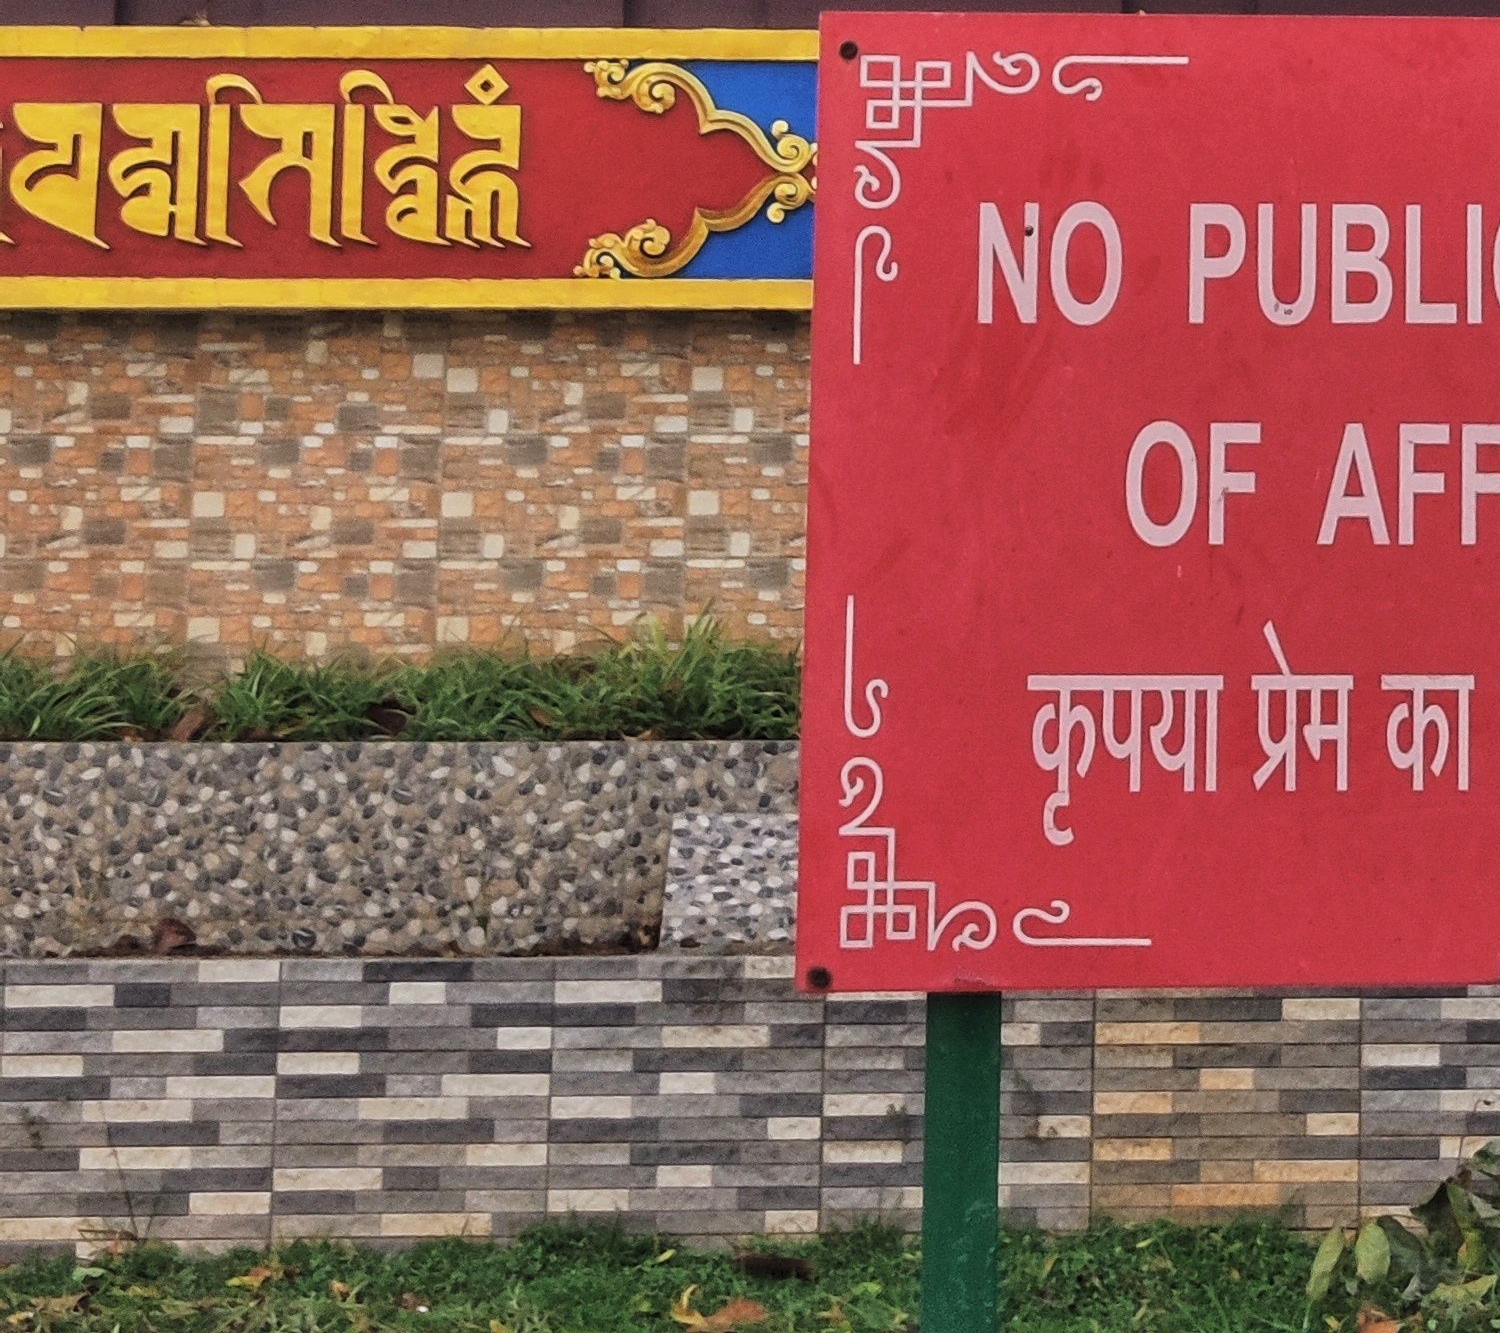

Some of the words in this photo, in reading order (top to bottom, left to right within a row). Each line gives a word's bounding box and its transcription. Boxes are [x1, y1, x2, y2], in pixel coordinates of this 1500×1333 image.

[977, 201, 1123, 326] NO
[1124, 420, 1262, 547] OF
[1027, 674, 1225, 846] कृपया
[1250, 620, 1354, 793] प्रेम
[1380, 674, 1475, 792] का
